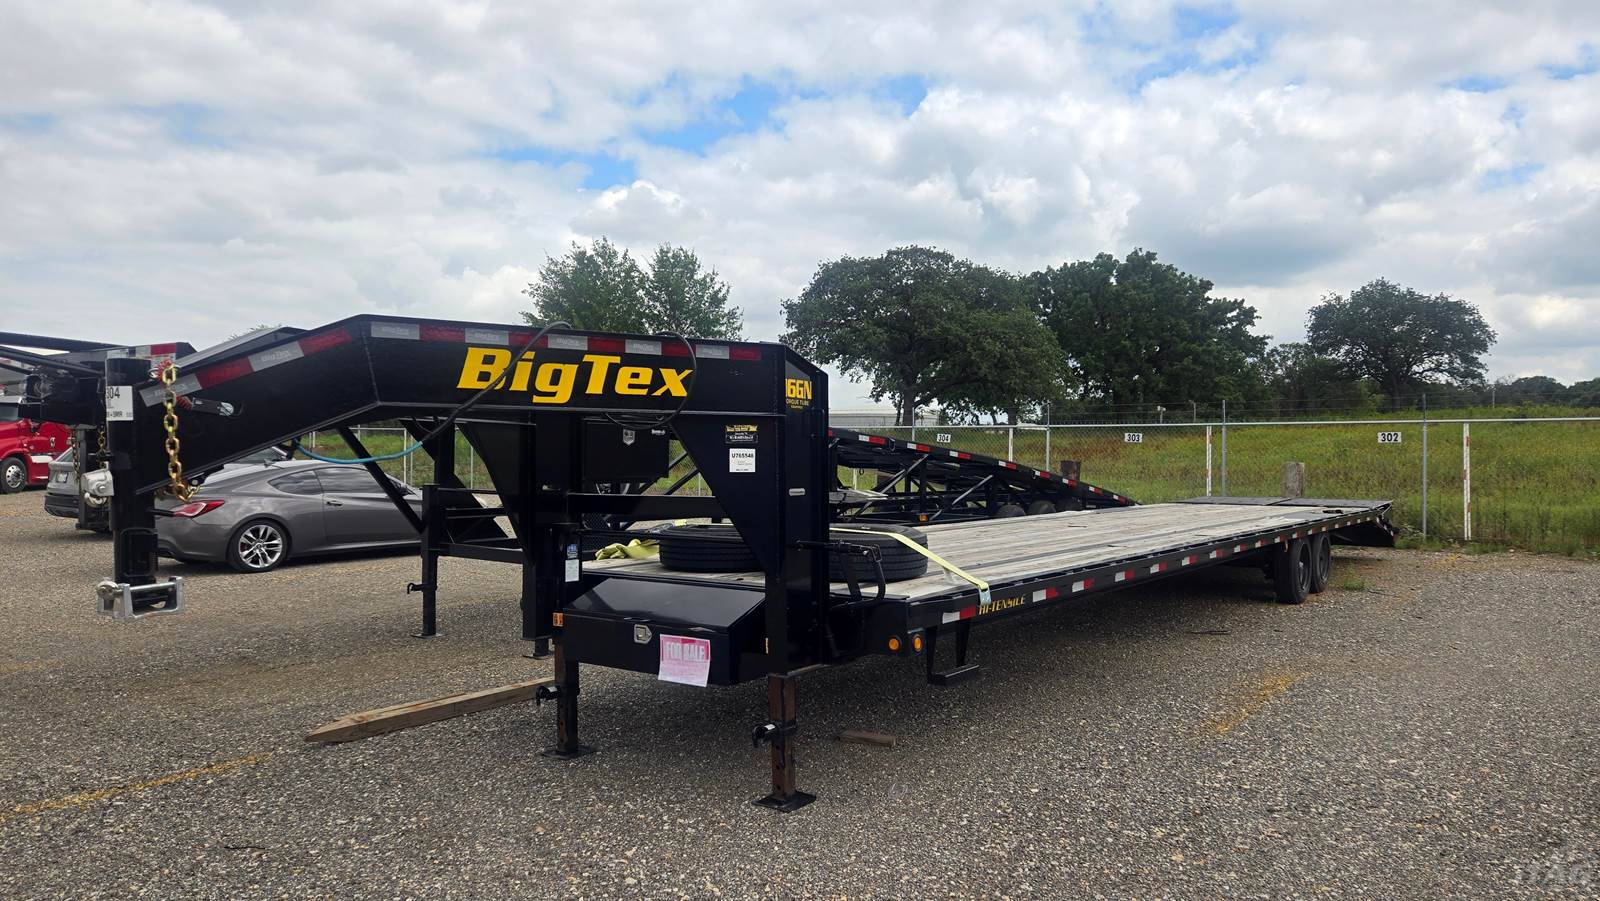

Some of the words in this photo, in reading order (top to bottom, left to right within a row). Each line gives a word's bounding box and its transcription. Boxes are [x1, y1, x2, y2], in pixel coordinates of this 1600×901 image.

[456, 346, 693, 404] BigTex
[938, 434, 949, 442] 304
[1127, 433, 1140, 442] 303
[1380, 432, 1399, 442] 302
[978, 596, 1026, 616] HI-TENSILE
[664, 641, 683, 660] FOR
[683, 643, 705, 662] SALE
